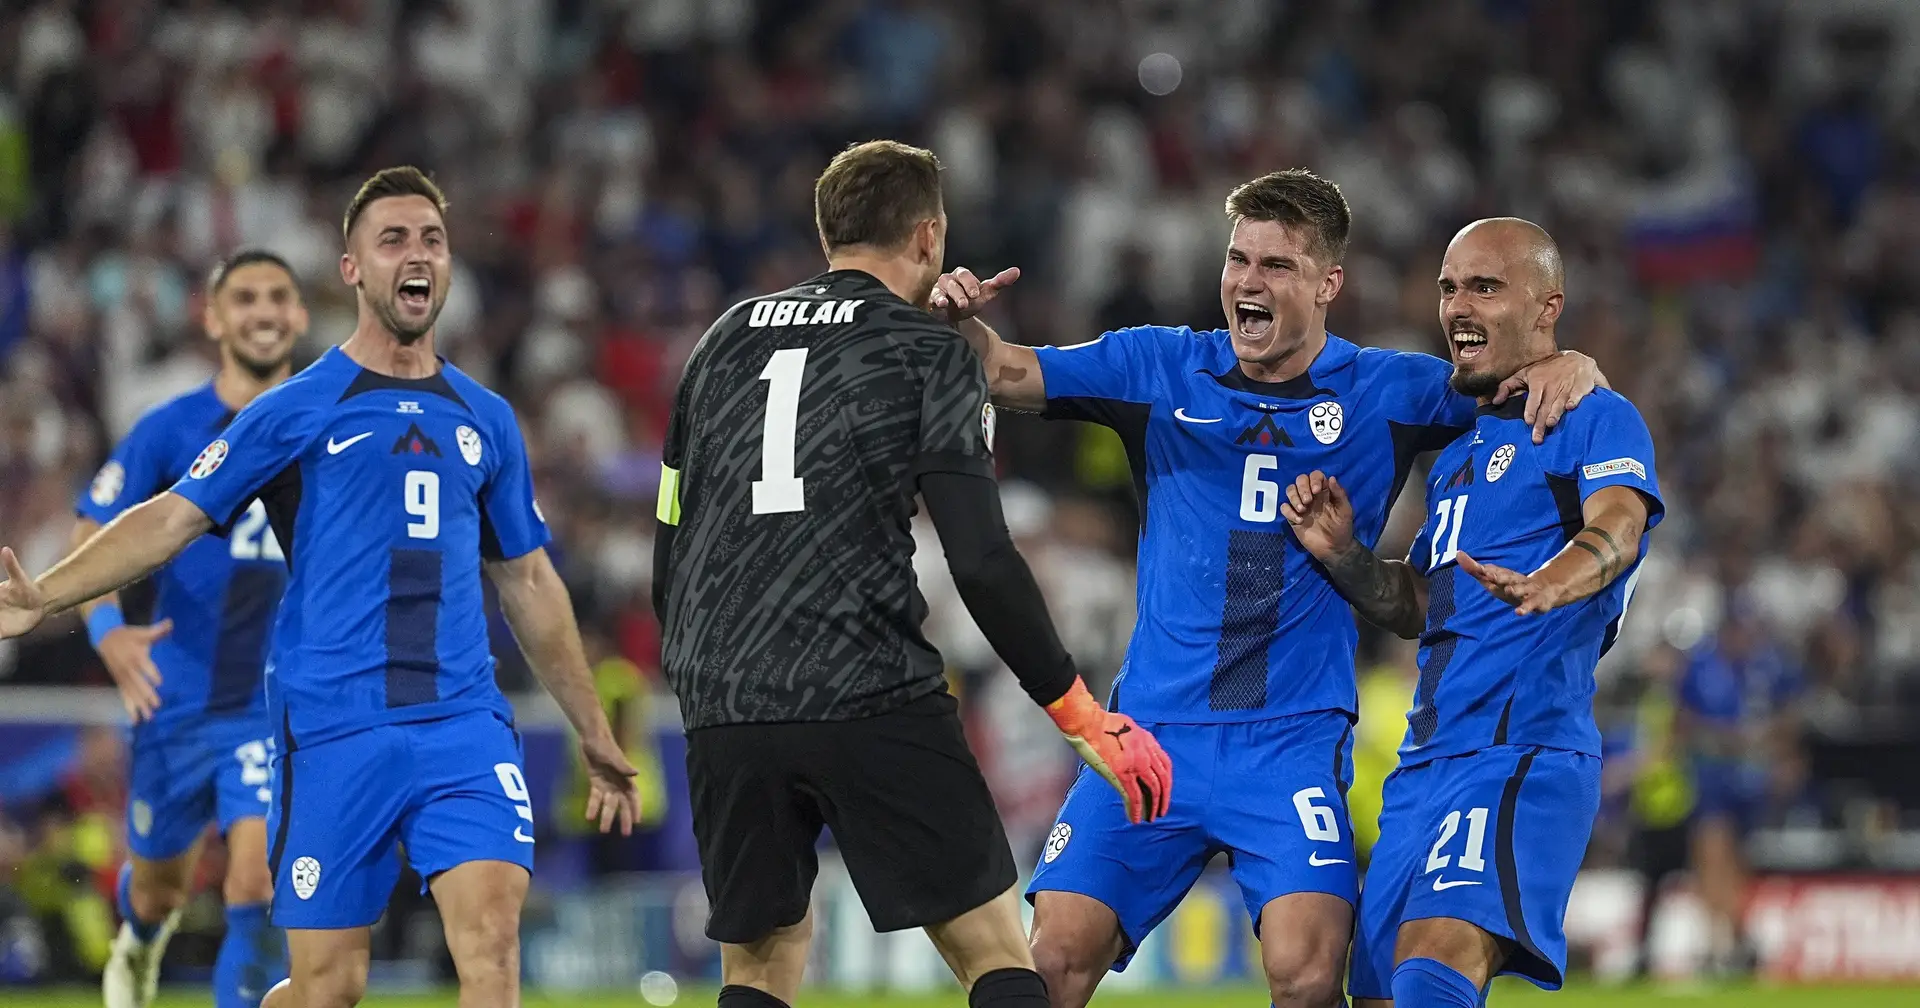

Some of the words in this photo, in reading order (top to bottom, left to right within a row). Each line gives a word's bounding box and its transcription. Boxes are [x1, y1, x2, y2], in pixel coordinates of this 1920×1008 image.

[748, 299, 865, 328] OBLAK
[751, 347, 809, 515] 1
[404, 470, 440, 539] 9
[1239, 453, 1279, 523] 6
[1428, 494, 1470, 569] 21
[493, 762, 534, 823] 9
[1292, 786, 1340, 843] 6
[1424, 807, 1489, 875] 21
